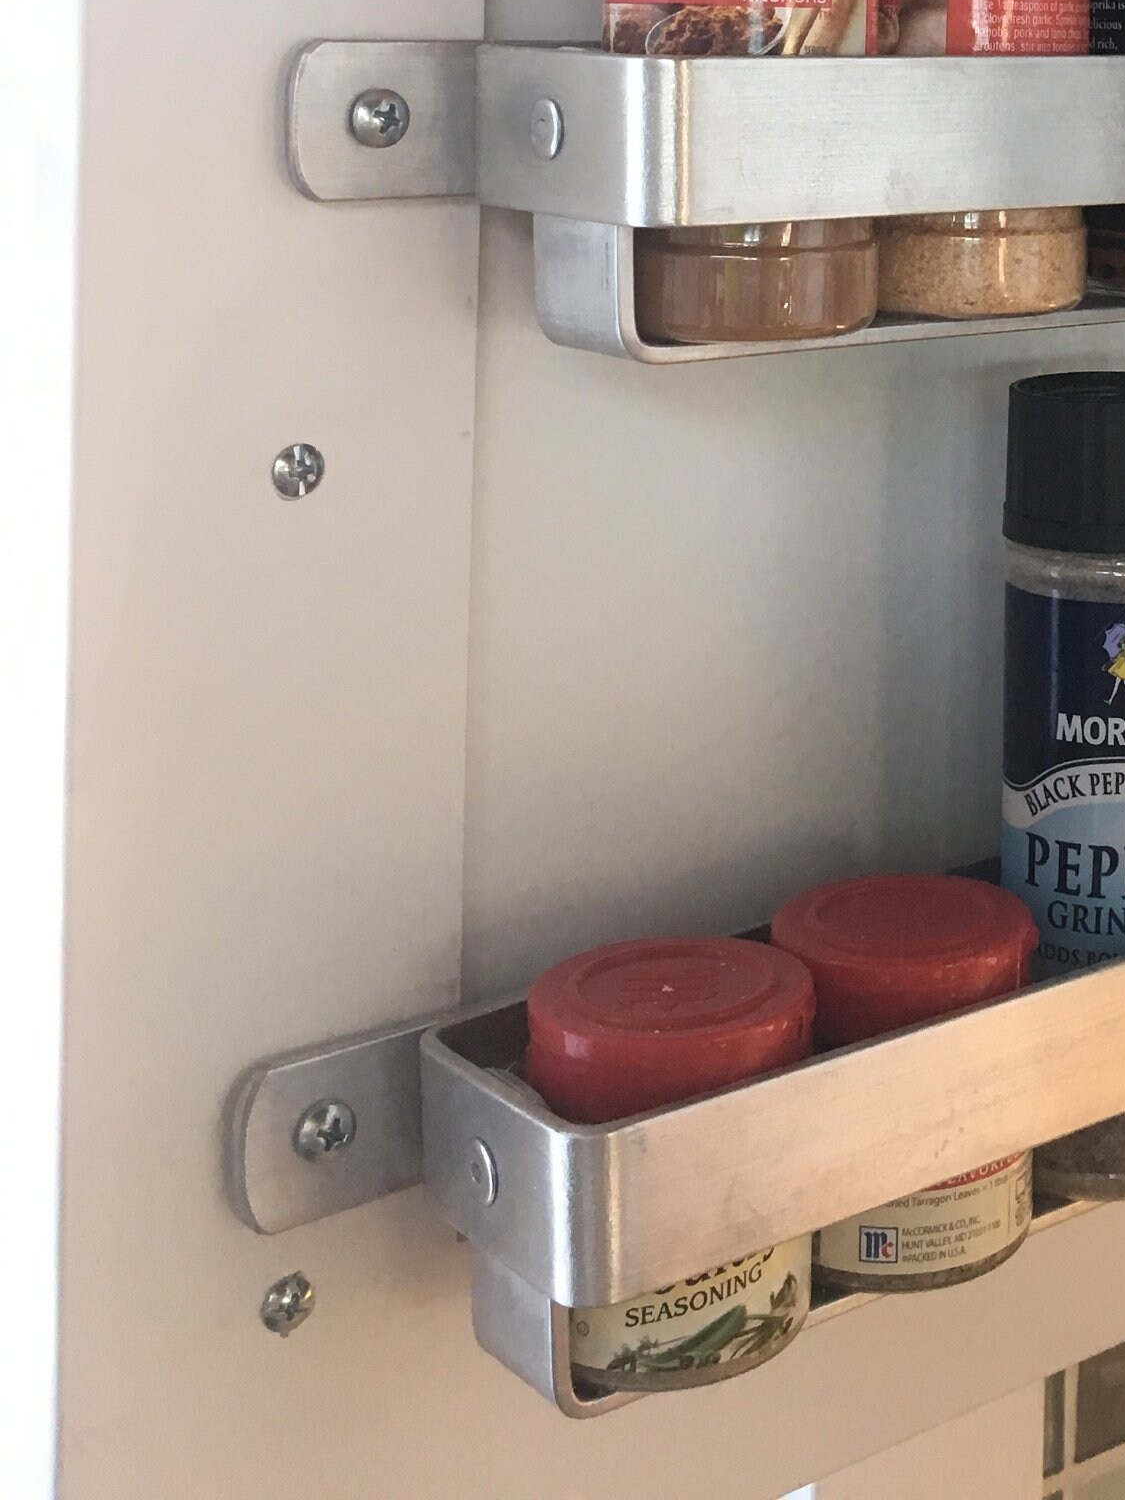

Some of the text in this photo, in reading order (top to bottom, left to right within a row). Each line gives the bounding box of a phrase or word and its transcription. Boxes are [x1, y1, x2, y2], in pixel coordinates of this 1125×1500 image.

[1025, 773, 1089, 817] BLACK
[911, 1187, 981, 1208] Tarragon Leaves
[901, 1239, 925, 1250] HUNT
[625, 1261, 763, 1328] SEASONING
